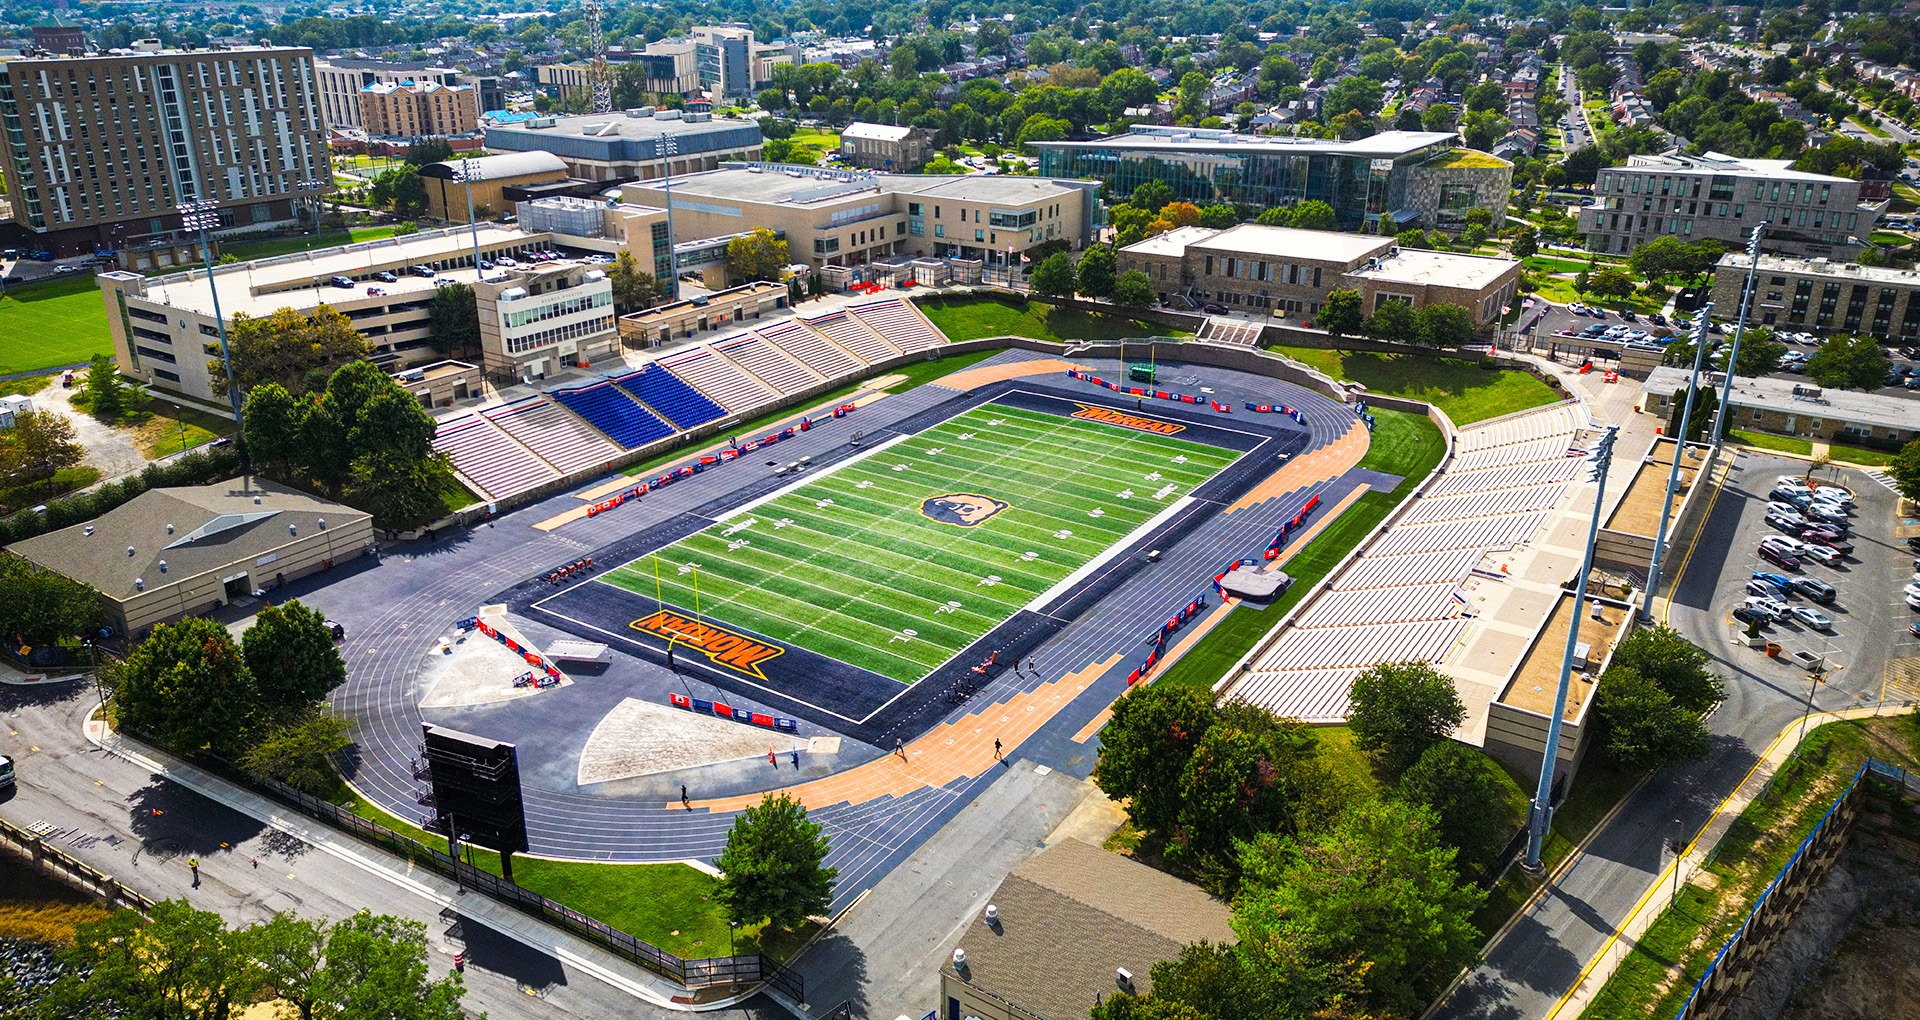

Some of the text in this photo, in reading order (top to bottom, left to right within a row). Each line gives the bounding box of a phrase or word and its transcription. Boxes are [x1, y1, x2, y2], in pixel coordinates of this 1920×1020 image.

[1080, 407, 1180, 434] MORGAN
[774, 518, 794, 528] 30
[728, 539, 750, 550] 20
[678, 562, 701, 574] 10
[937, 601, 962, 613] 20
[638, 612, 778, 670] MORGAN
[893, 629, 918, 642] 10
